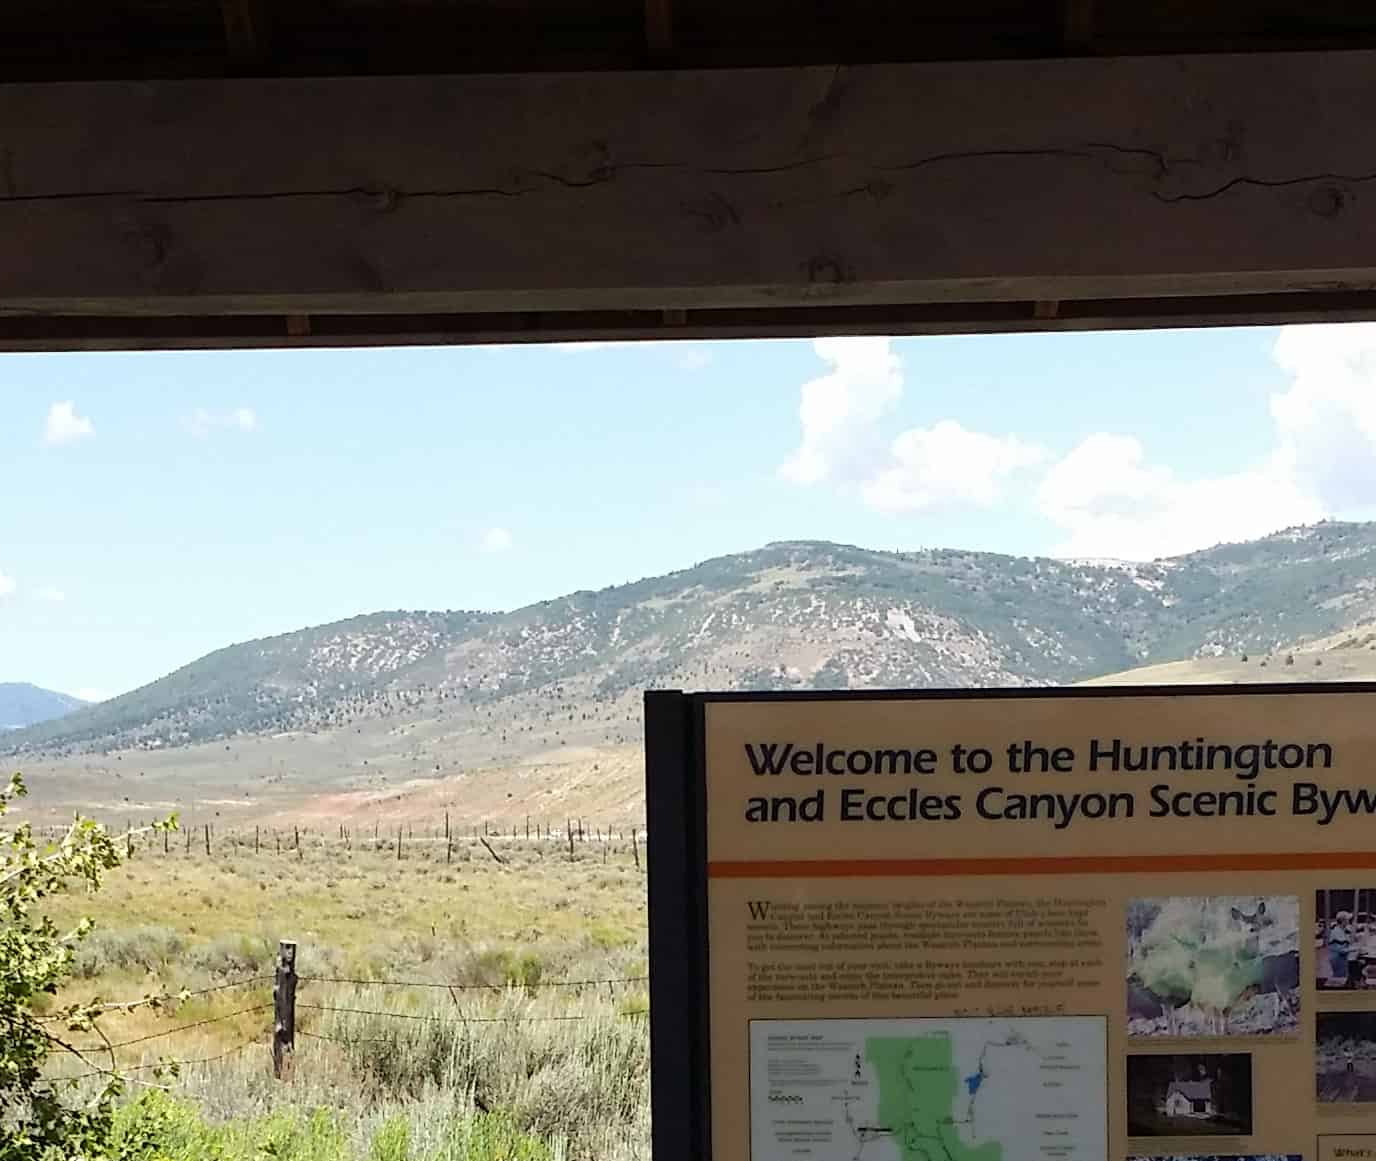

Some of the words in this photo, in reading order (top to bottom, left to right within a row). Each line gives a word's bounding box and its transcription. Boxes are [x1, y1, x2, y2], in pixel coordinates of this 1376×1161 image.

[745, 740, 938, 777] Welcome
[951, 745, 992, 775] to
[1007, 740, 1075, 774] the
[1087, 737, 1333, 779] Huntington
[744, 789, 826, 824] and
[839, 785, 962, 823] Eccles
[976, 783, 1135, 829] Canyon
[1148, 780, 1278, 818] Scenic
[1334, 1145, 1372, 1158] What's
